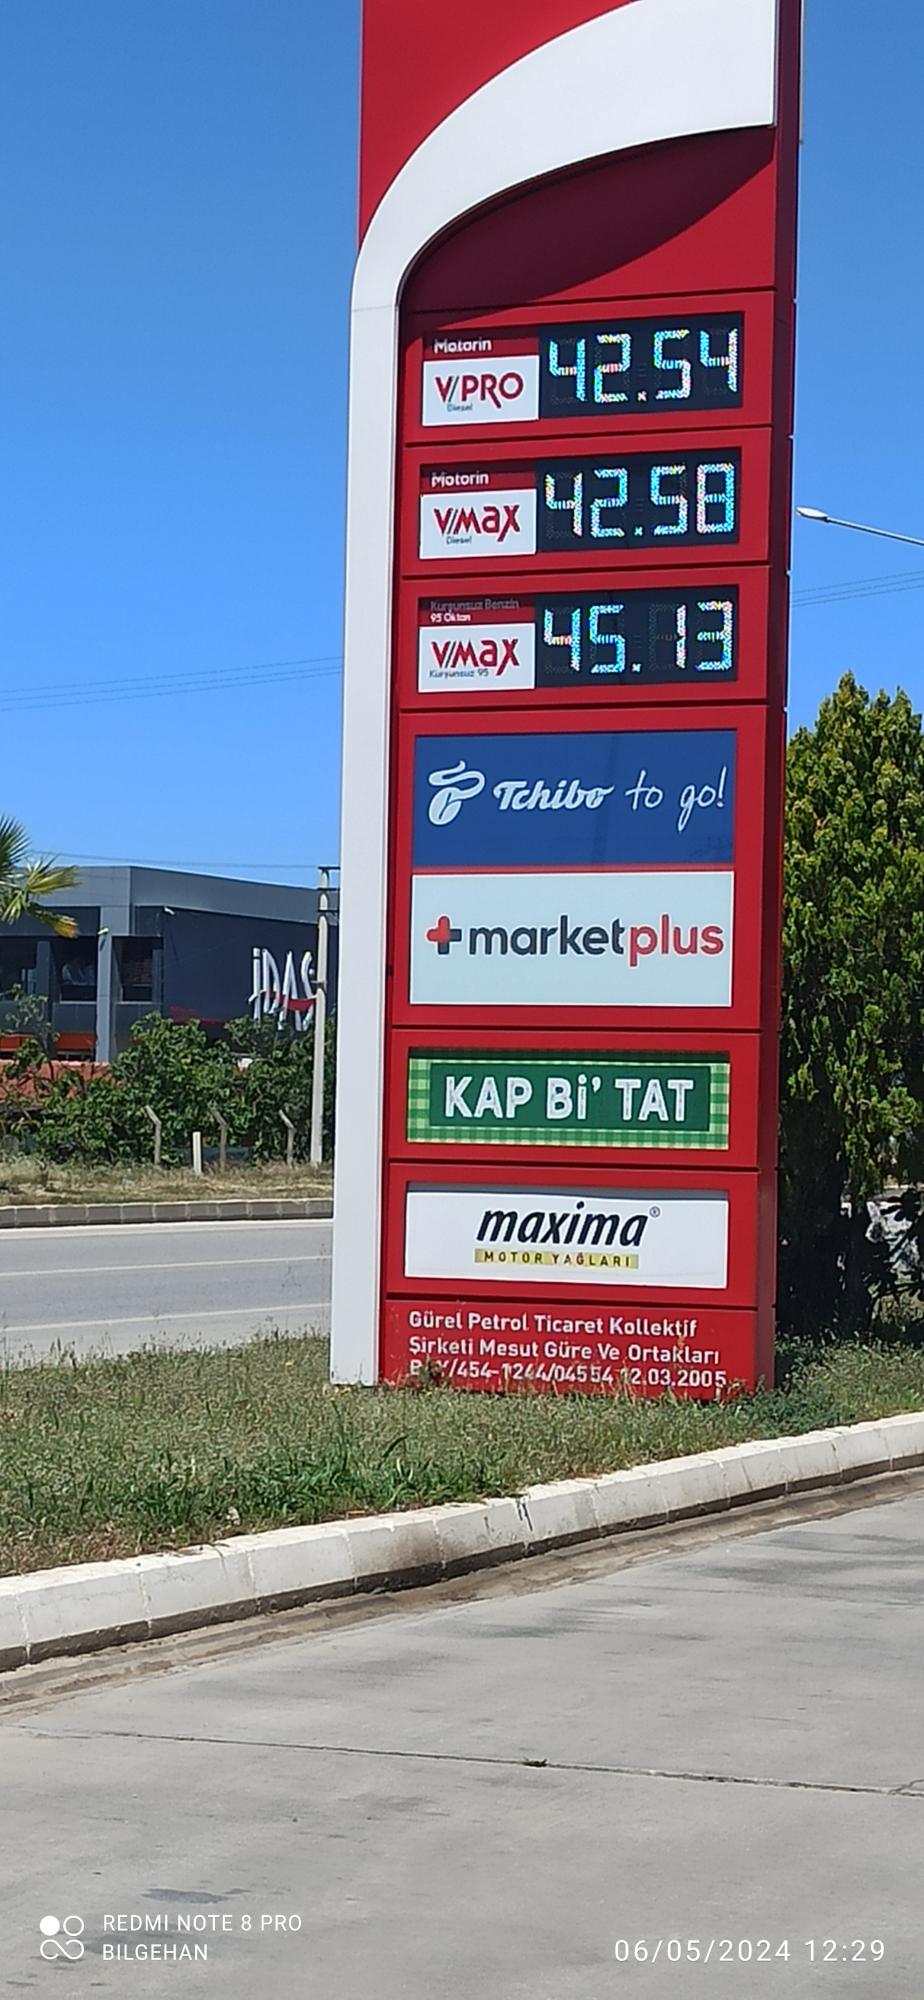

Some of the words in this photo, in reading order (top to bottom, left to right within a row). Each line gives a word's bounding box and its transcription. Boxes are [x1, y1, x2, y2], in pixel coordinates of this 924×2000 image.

[434, 338, 492, 354] Motorin
[549, 328, 738, 403] 42.54
[447, 404, 473, 412] Diesel
[431, 470, 489, 487] Motorin
[545, 463, 735, 538] 42.58
[446, 535, 472, 545] Diesel
[484, 598, 520, 610] Benzin
[430, 613, 442, 623] 95
[443, 611, 471, 622] Oktan
[544, 601, 733, 673] 45.13
[477, 668, 489, 677] 95
[493, 779, 615, 811] Tchibo
[625, 770, 664, 811] to
[677, 766, 727, 832] go!
[445, 1076, 533, 1119] KAP
[614, 1079, 694, 1122] TAT
[476, 1201, 648, 1247] maxima
[484, 1251, 543, 1264] MOTOR
[552, 1252, 630, 1267] YAĞLARI
[409, 1311, 462, 1330] Gürel
[468, 1313, 527, 1332] Petrol
[534, 1315, 603, 1334] Ticaret
[609, 1317, 698, 1338] Kollektif
[409, 1336, 473, 1356] Şirketi
[480, 1338, 538, 1357] Mesut
[544, 1341, 592, 1360] Güre
[597, 1344, 620, 1361] Ve
[628, 1345, 720, 1365] Ortakları
